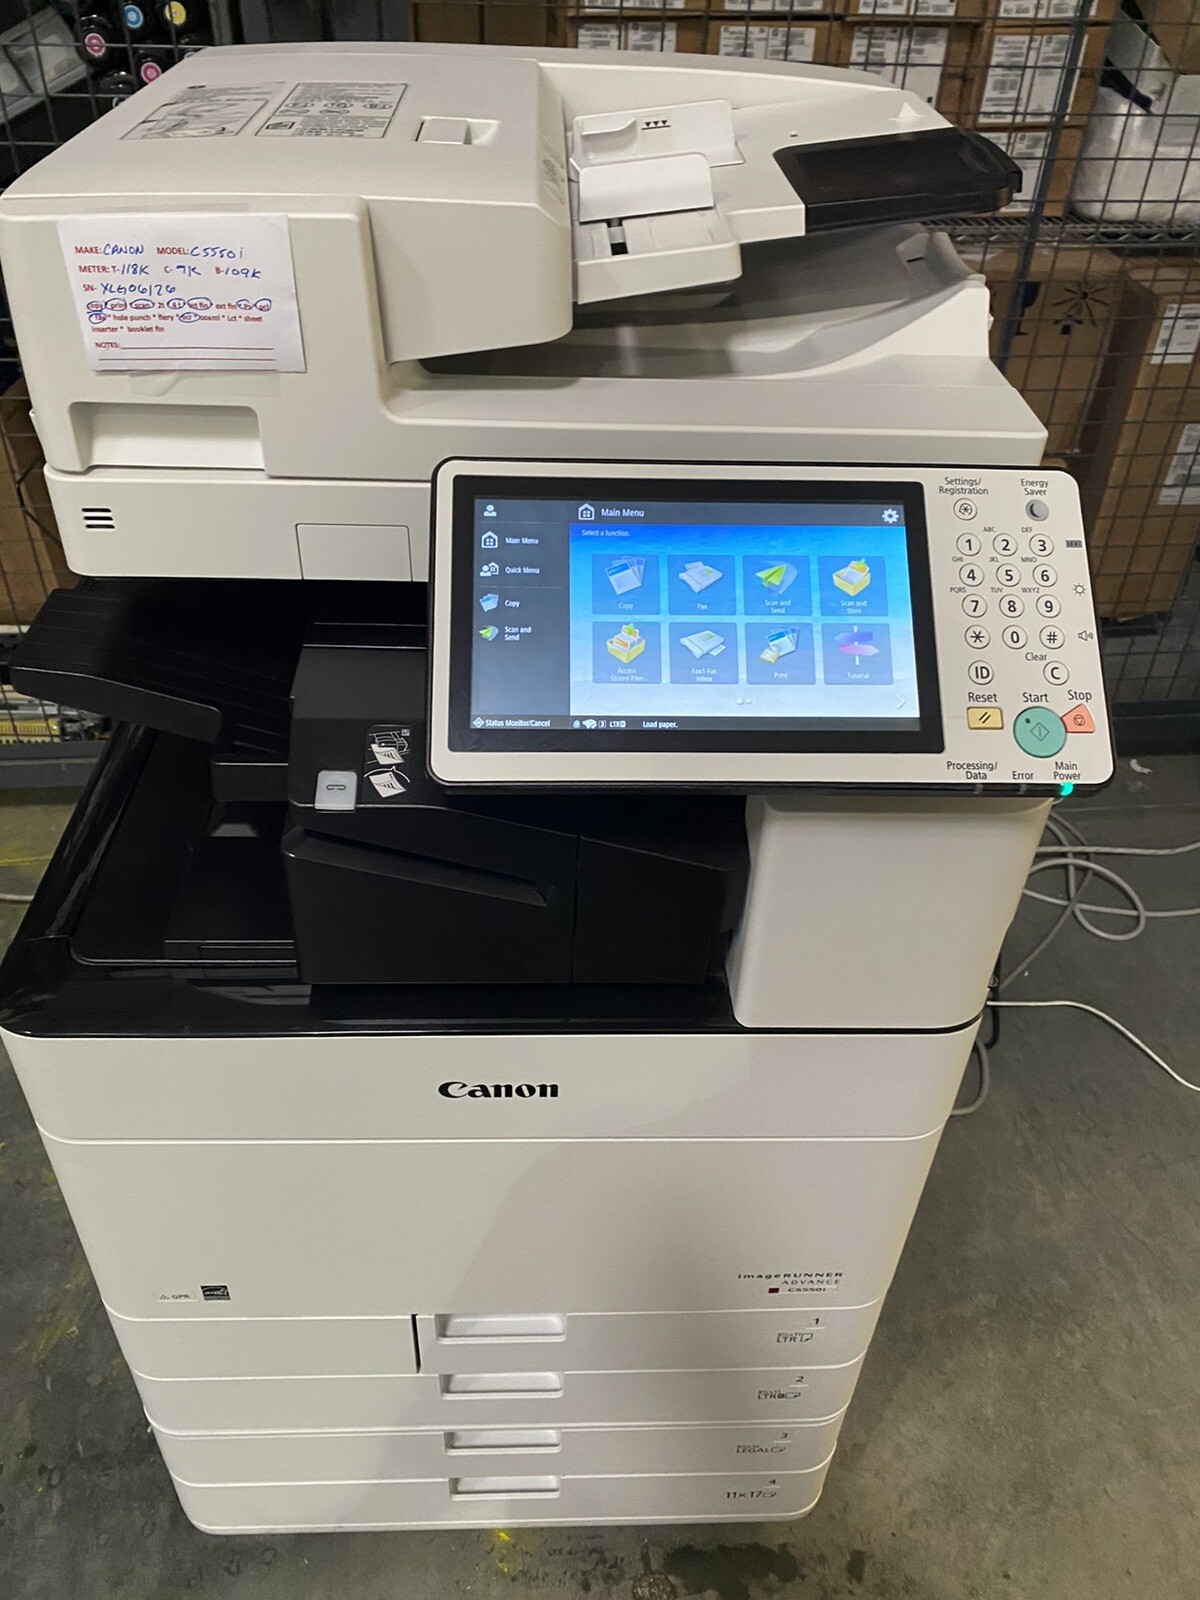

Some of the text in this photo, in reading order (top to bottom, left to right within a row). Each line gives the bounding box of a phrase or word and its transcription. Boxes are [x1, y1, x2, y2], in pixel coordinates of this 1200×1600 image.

[75, 246, 102, 254] MAKE:
[103, 243, 144, 256] CANON
[157, 247, 189, 255] MODEL:
[78, 265, 110, 273] METER:
[944, 477, 981, 486] Settings/
[1020, 478, 1048, 488] Energy
[938, 486, 989, 495] Registration
[1024, 487, 1047, 496] Saver
[601, 508, 645, 517] Main Menu
[581, 529, 599, 537] Select
[505, 536, 539, 544] Main Menu
[965, 539, 972, 551] 1
[1001, 539, 1011, 551] 2
[1038, 539, 1047, 552] 3
[505, 567, 540, 575] Quick Menu
[966, 569, 976, 581] 4
[1005, 569, 1014, 582] 5
[1041, 569, 1050, 582] 6
[504, 600, 520, 608] Copy
[619, 602, 634, 610] Copy
[970, 600, 979, 612] 7
[1007, 600, 1017, 613] 8
[1044, 600, 1053, 613] 9
[1010, 631, 1020, 644] 0
[1046, 631, 1058, 644] #
[1025, 652, 1047, 661] Clear
[974, 666, 990, 679] ID
[1051, 667, 1061, 680] C
[968, 692, 997, 703] Reset
[1022, 692, 1049, 703] Start
[1067, 689, 1092, 702] Stop
[485, 719, 504, 727] Status
[658, 721, 678, 729] paper.
[947, 761, 998, 771] Processing/
[1055, 761, 1078, 770] Main
[966, 771, 987, 780] Data
[1012, 771, 1034, 780] Error
[1053, 771, 1081, 780] Power
[438, 1081, 559, 1099] Canon
[738, 1272, 843, 1280] imageRUNNER
[795, 1375, 804, 1383] 2
